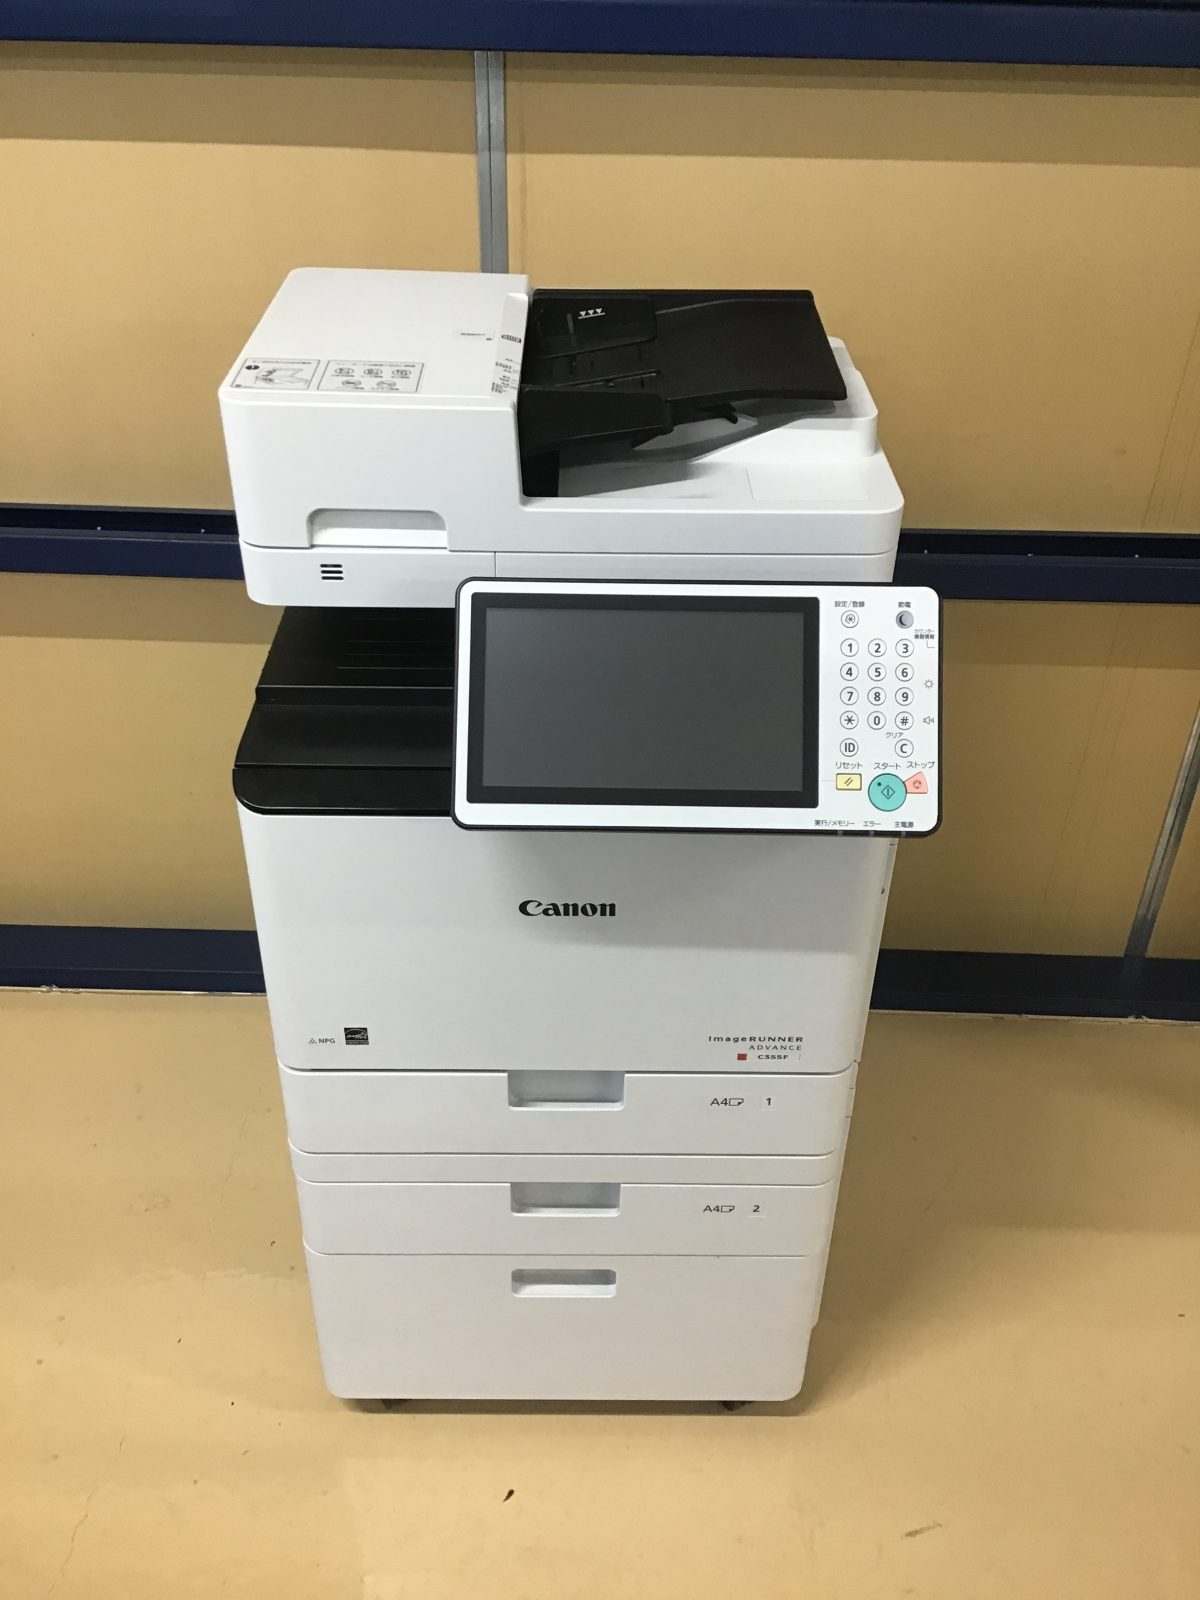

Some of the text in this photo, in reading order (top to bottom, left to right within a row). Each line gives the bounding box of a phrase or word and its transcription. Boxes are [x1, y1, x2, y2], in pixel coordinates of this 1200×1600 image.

[847, 643, 853, 653] 1
[874, 643, 881, 653] 2
[902, 643, 909, 653] 3
[845, 667, 853, 677] 4
[874, 667, 881, 677] 5
[901, 667, 909, 677] 6
[847, 691, 854, 701] 7
[873, 691, 881, 702] 8
[901, 691, 909, 702] 9
[873, 715, 880, 725] 0
[900, 716, 909, 726] #
[844, 742, 856, 753] ID
[900, 743, 908, 754] C
[906, 761, 936, 769] ストップ
[814, 819, 856, 827] 実行/メモリー
[518, 900, 617, 917] Canon
[710, 1097, 772, 1106] A4 1
[702, 1204, 760, 1213] A4 2
